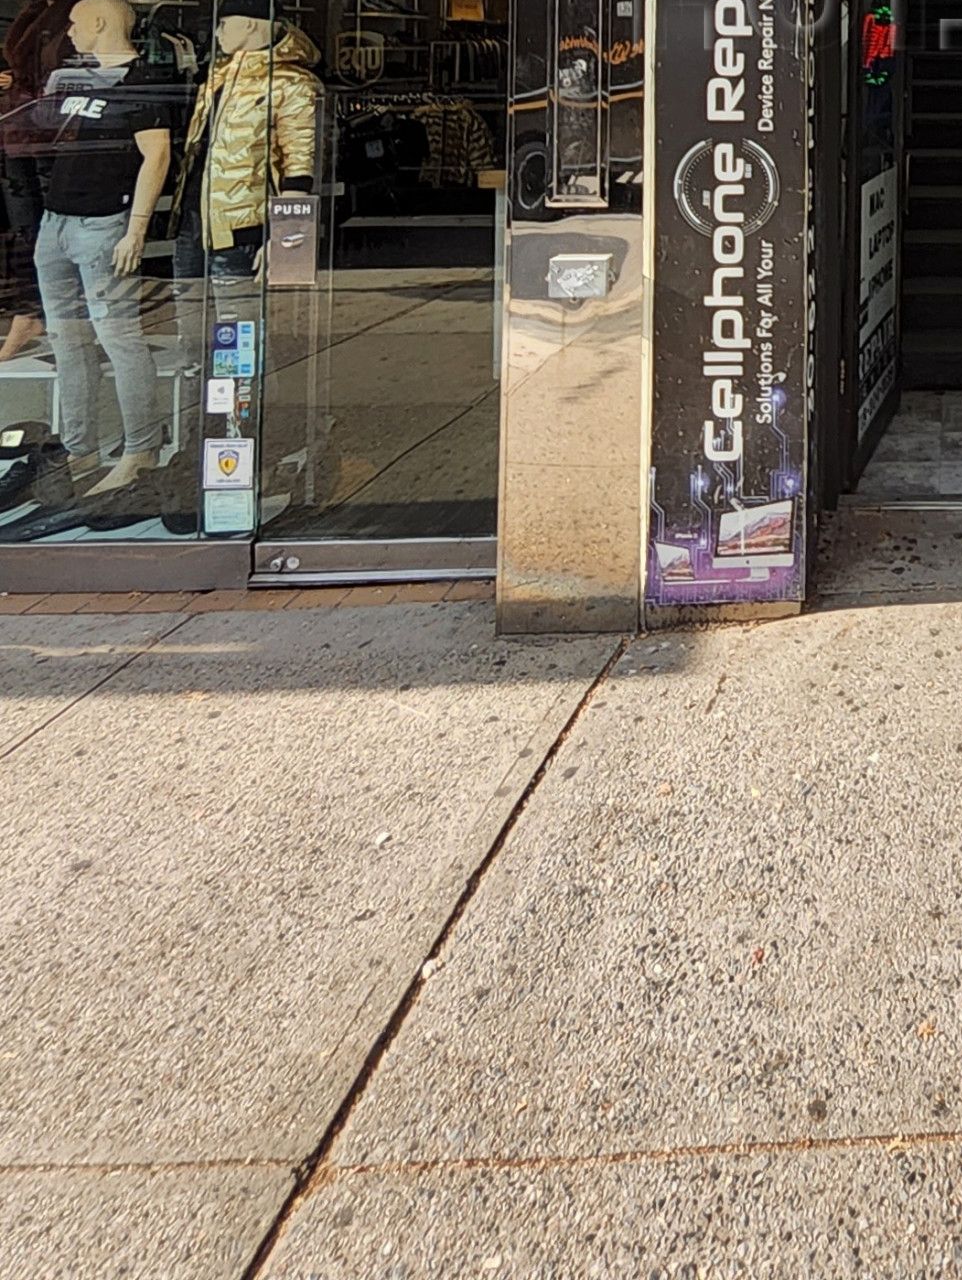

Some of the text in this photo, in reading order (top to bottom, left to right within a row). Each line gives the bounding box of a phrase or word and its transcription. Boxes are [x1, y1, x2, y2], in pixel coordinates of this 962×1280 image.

[757, 15, 777, 70] Repair
[757, 75, 774, 132] Device
[274, 204, 311, 215] PUSH
[756, 239, 774, 274] Your
[703, 142, 752, 462] Cellphone
[756, 279, 773, 305] All
[756, 306, 773, 338] For
[756, 340, 773, 424] Solutions
